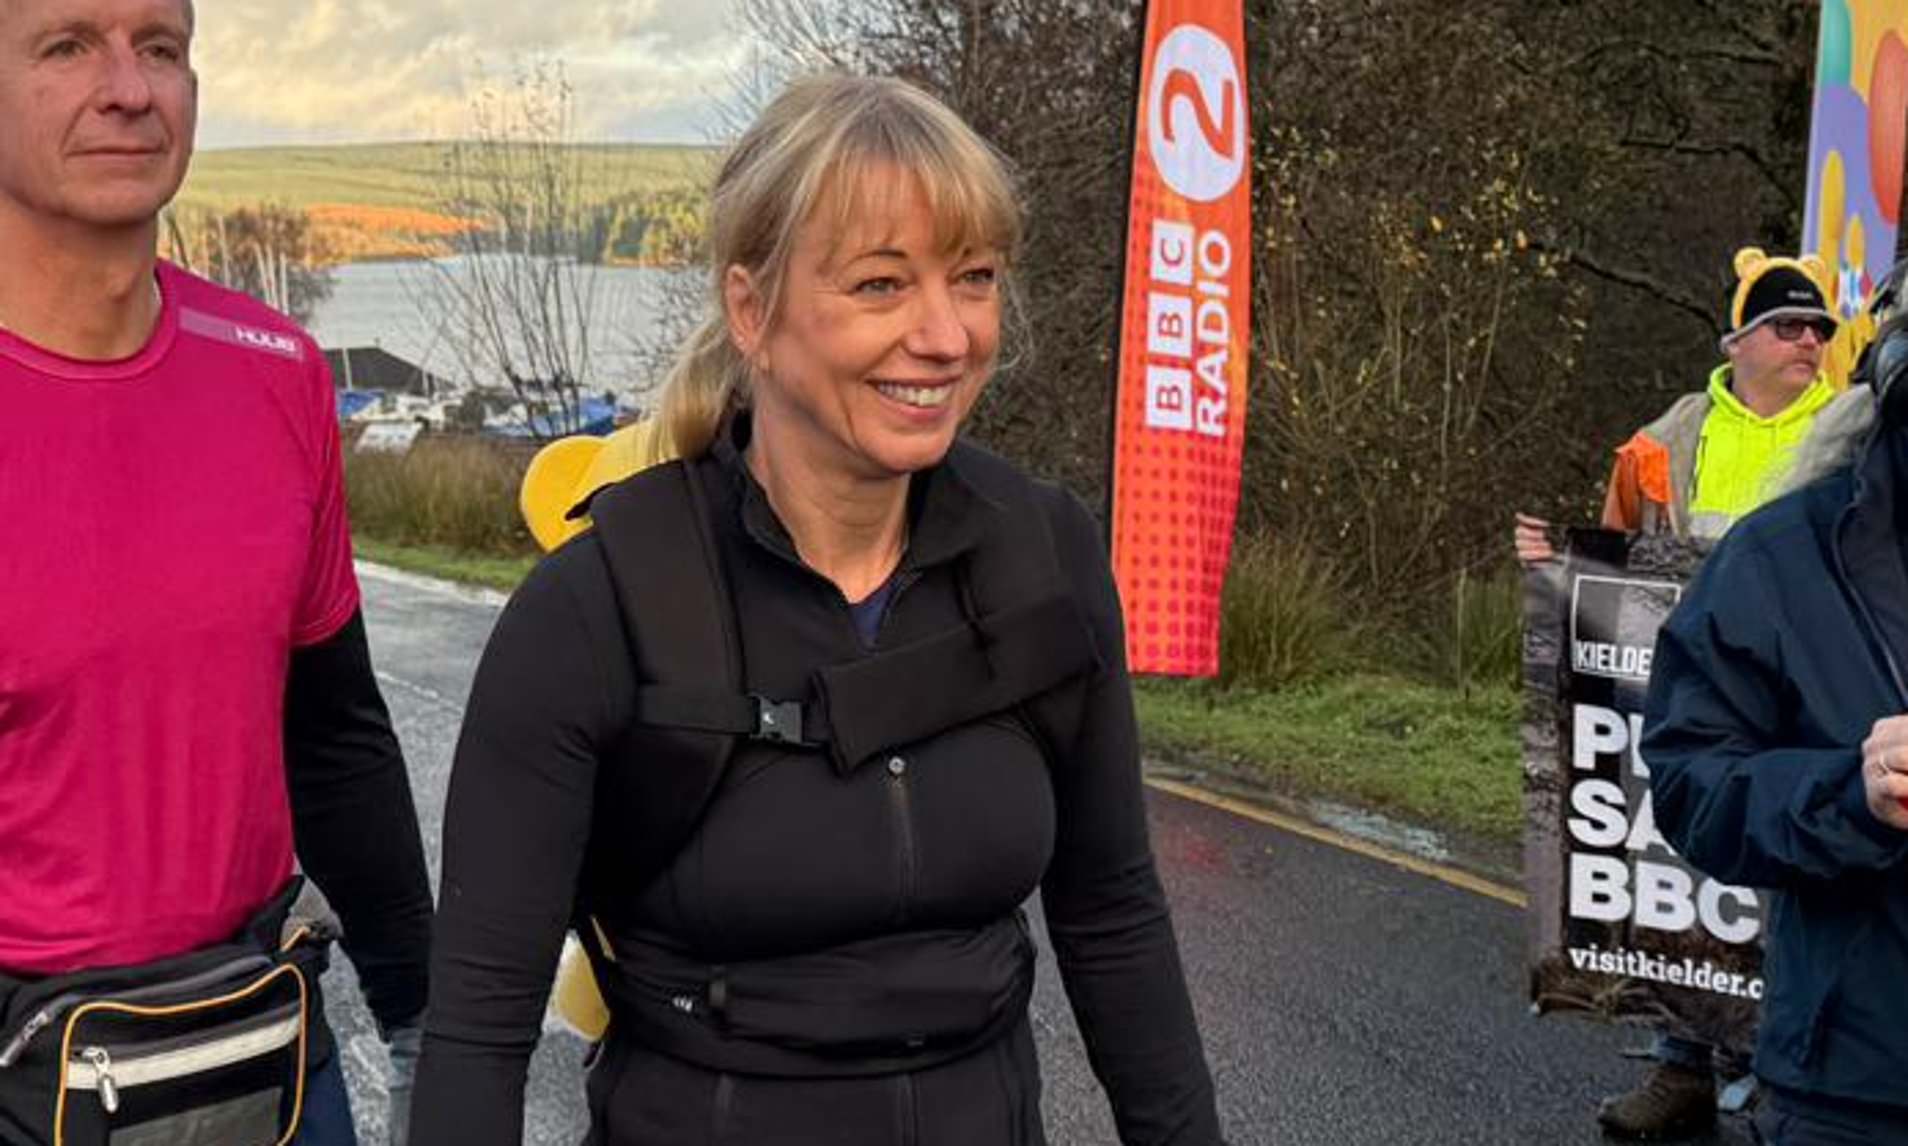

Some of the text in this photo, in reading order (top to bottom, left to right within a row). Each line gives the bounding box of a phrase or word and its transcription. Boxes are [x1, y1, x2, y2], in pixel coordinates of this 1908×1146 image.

[1160, 67, 1235, 160] 2
[1153, 233, 1188, 415] BBC
[1195, 229, 1231, 437] RADIO
[1577, 641, 1654, 676] KIELDE
[1573, 703, 1651, 780] PL
[1567, 778, 1680, 857] SA
[1569, 852, 1761, 944] BBC
[1568, 942, 1764, 1000] visitkielder.c
